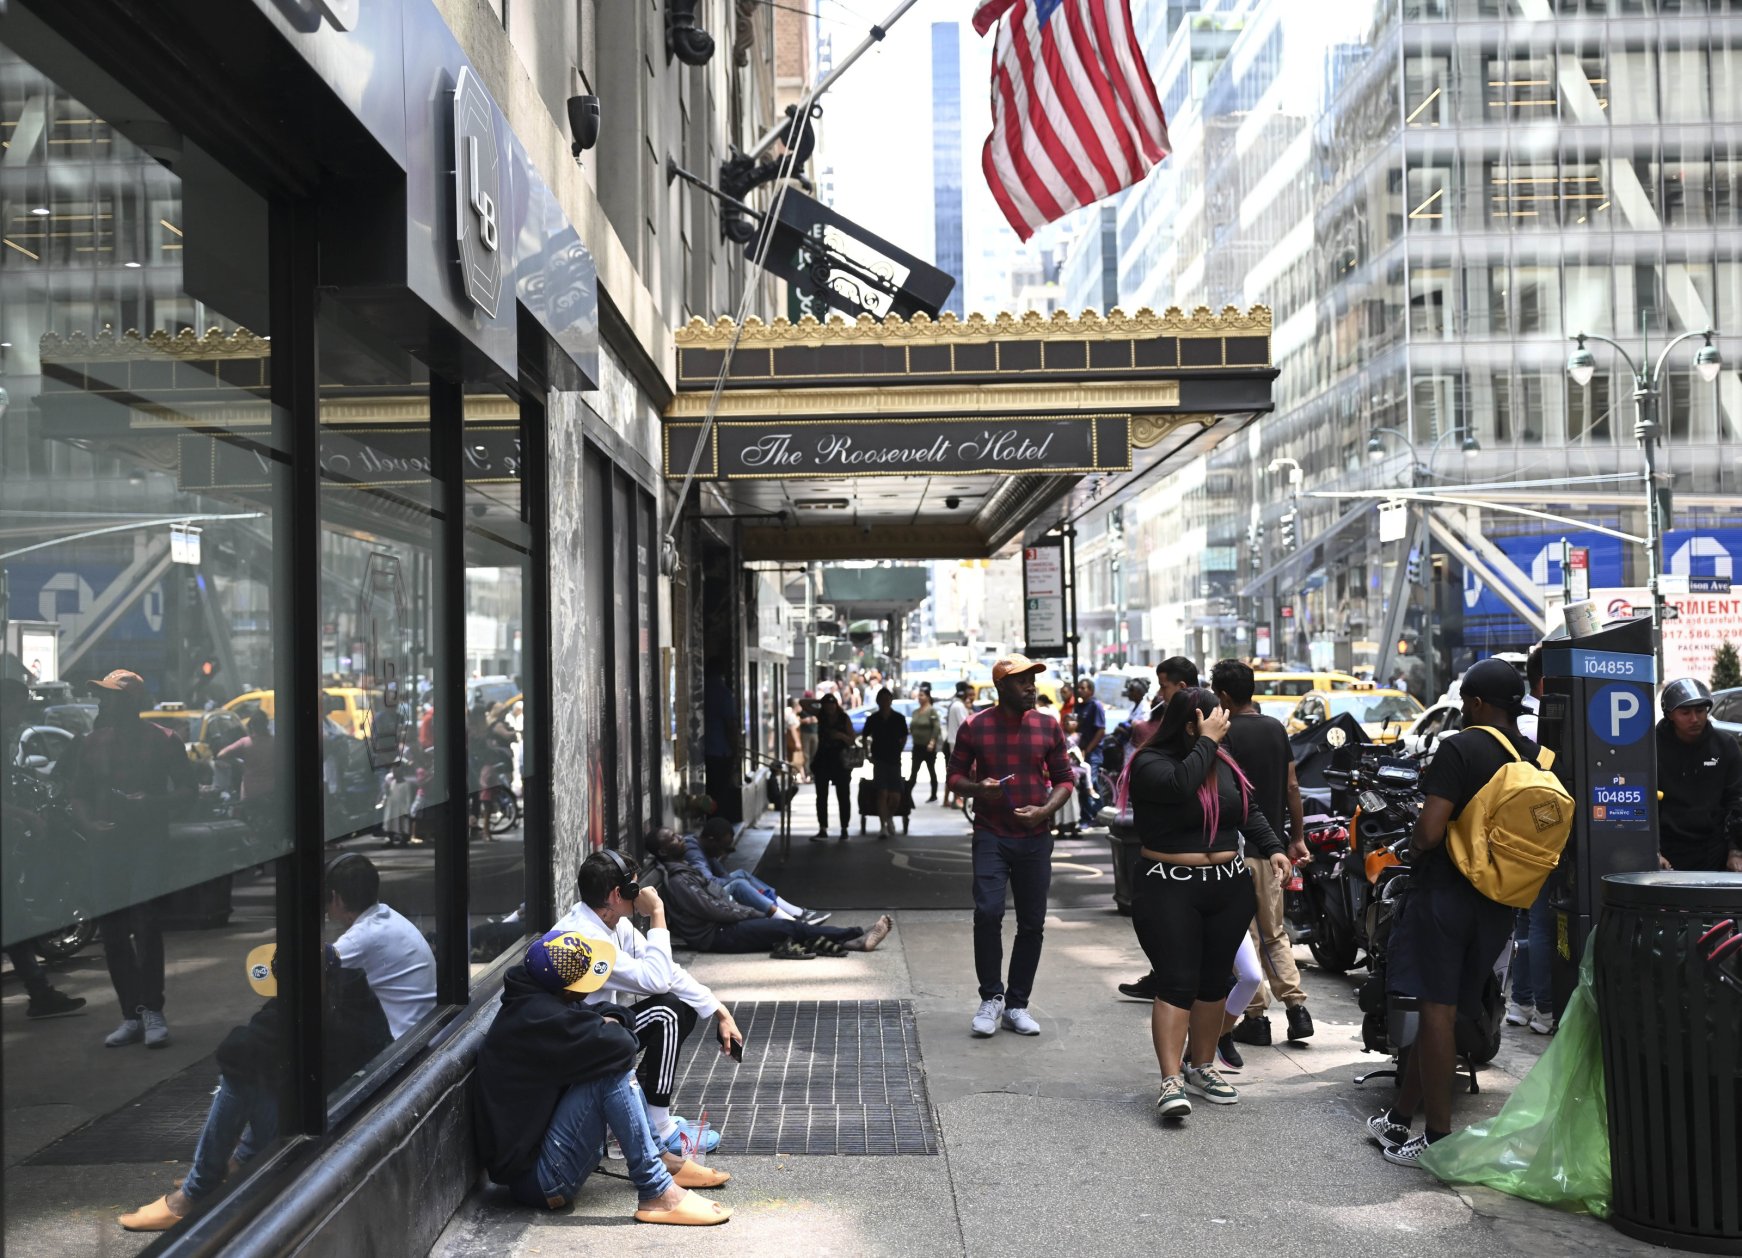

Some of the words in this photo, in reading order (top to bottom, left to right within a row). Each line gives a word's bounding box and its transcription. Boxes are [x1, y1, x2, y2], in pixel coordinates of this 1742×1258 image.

[741, 433, 803, 466] The
[814, 432, 952, 464] Roosevelt
[957, 430, 1054, 461] Hotel
[1711, 580, 1728, 590] Ave
[1665, 600, 1741, 615] RMIENT
[1584, 660, 1634, 675] 104855
[1610, 691, 1640, 737] P
[1597, 791, 1641, 803] 104855
[1146, 854, 1245, 881] ACTIVE
